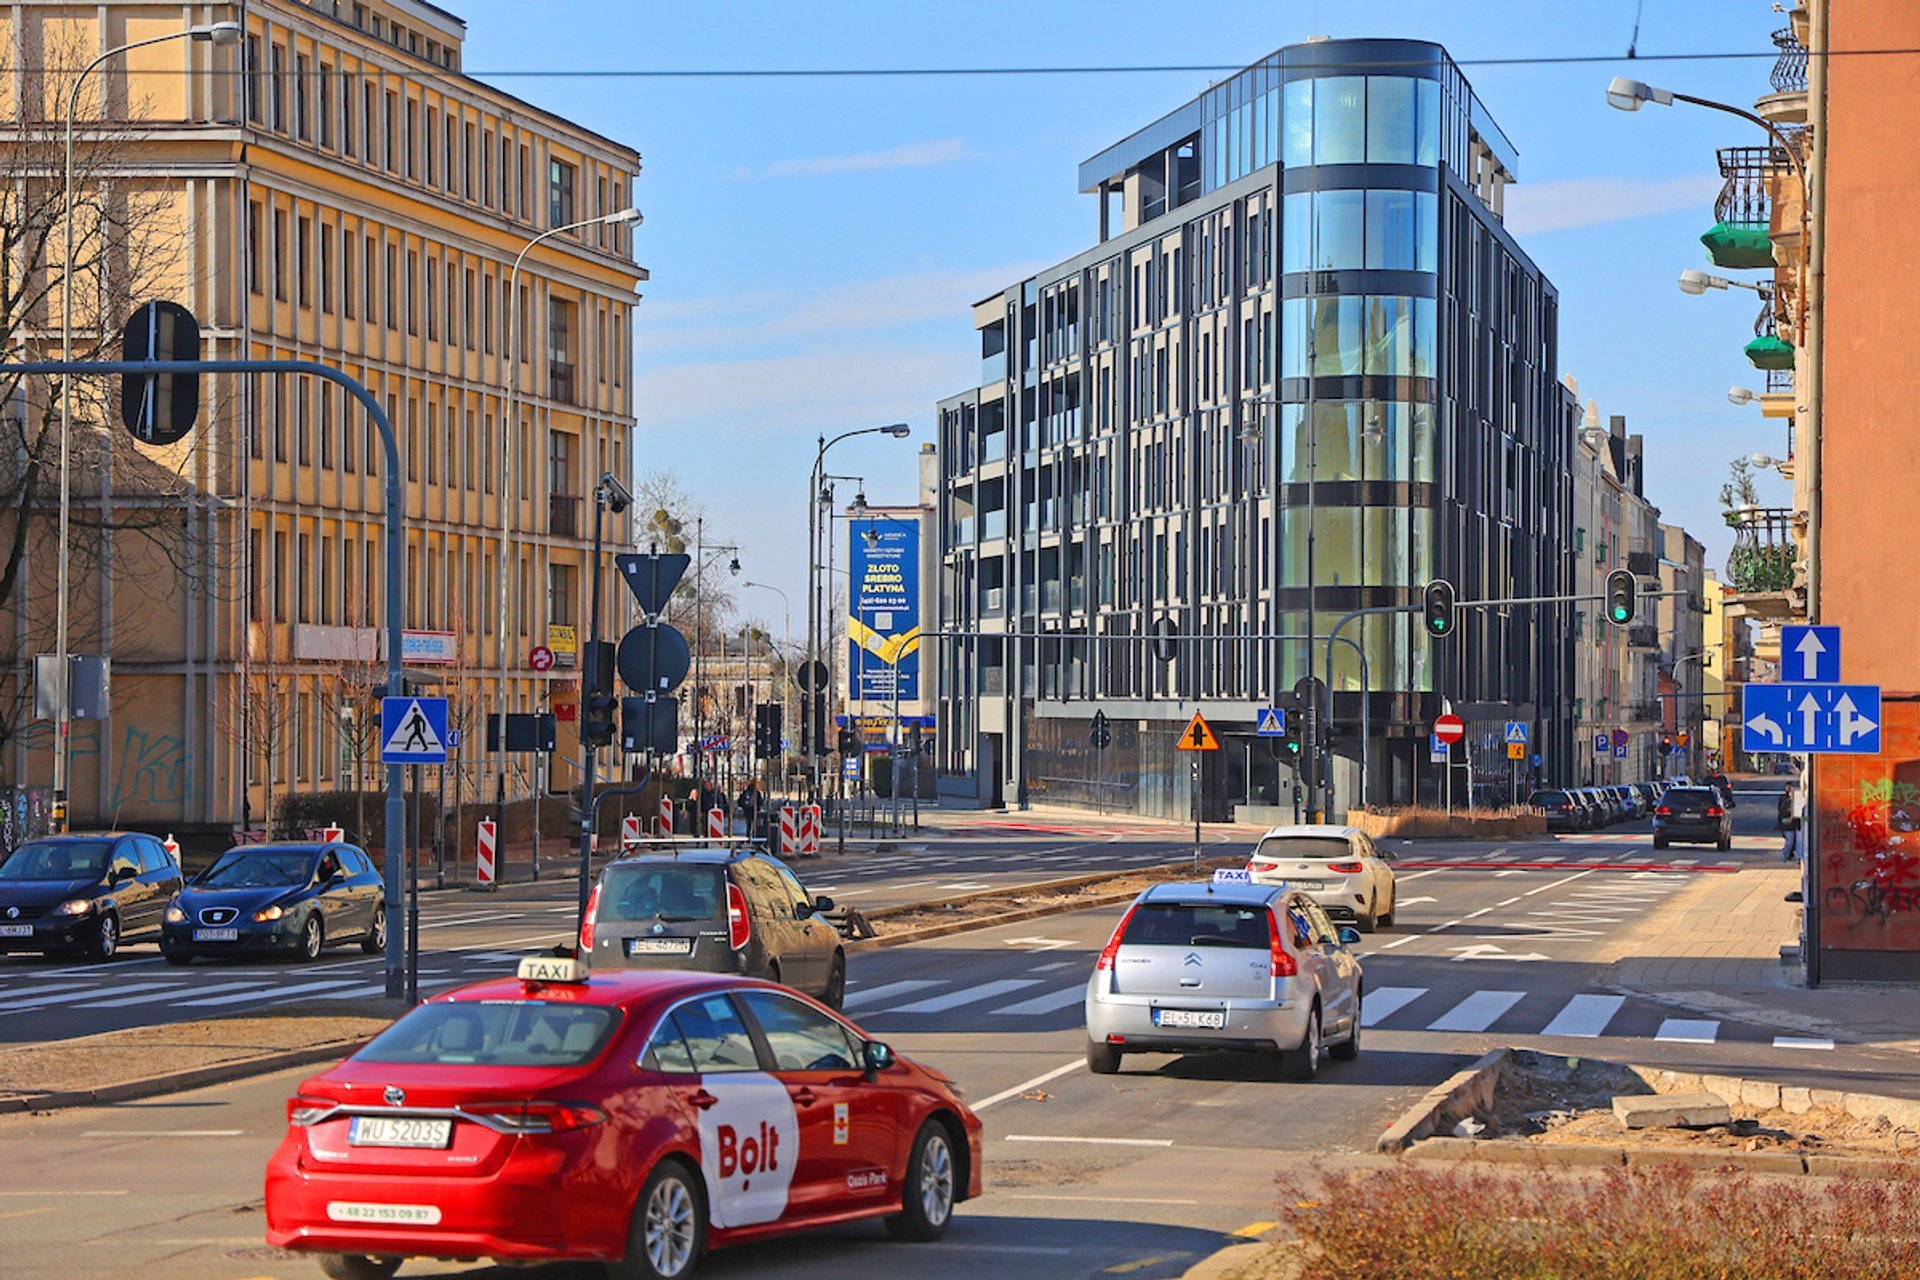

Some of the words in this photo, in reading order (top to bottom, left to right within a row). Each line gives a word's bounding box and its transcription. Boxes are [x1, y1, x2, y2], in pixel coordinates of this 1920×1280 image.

[867, 564, 900, 573] ZŁOTO
[864, 574, 903, 583] SREBRO
[862, 584, 905, 593] PLATYNA
[1218, 871, 1249, 880] TAXI
[526, 963, 569, 979] TAXI
[1163, 1011, 1178, 1024] EL
[361, 1118, 386, 1139] WU
[717, 1119, 779, 1182] Bolt
[869, 1171, 888, 1185] Park
[346, 1207, 360, 1217] 48
[363, 1207, 376, 1218] 22
[379, 1208, 396, 1219] 153
[399, 1209, 413, 1219] 09
[416, 1209, 429, 1220] 87
